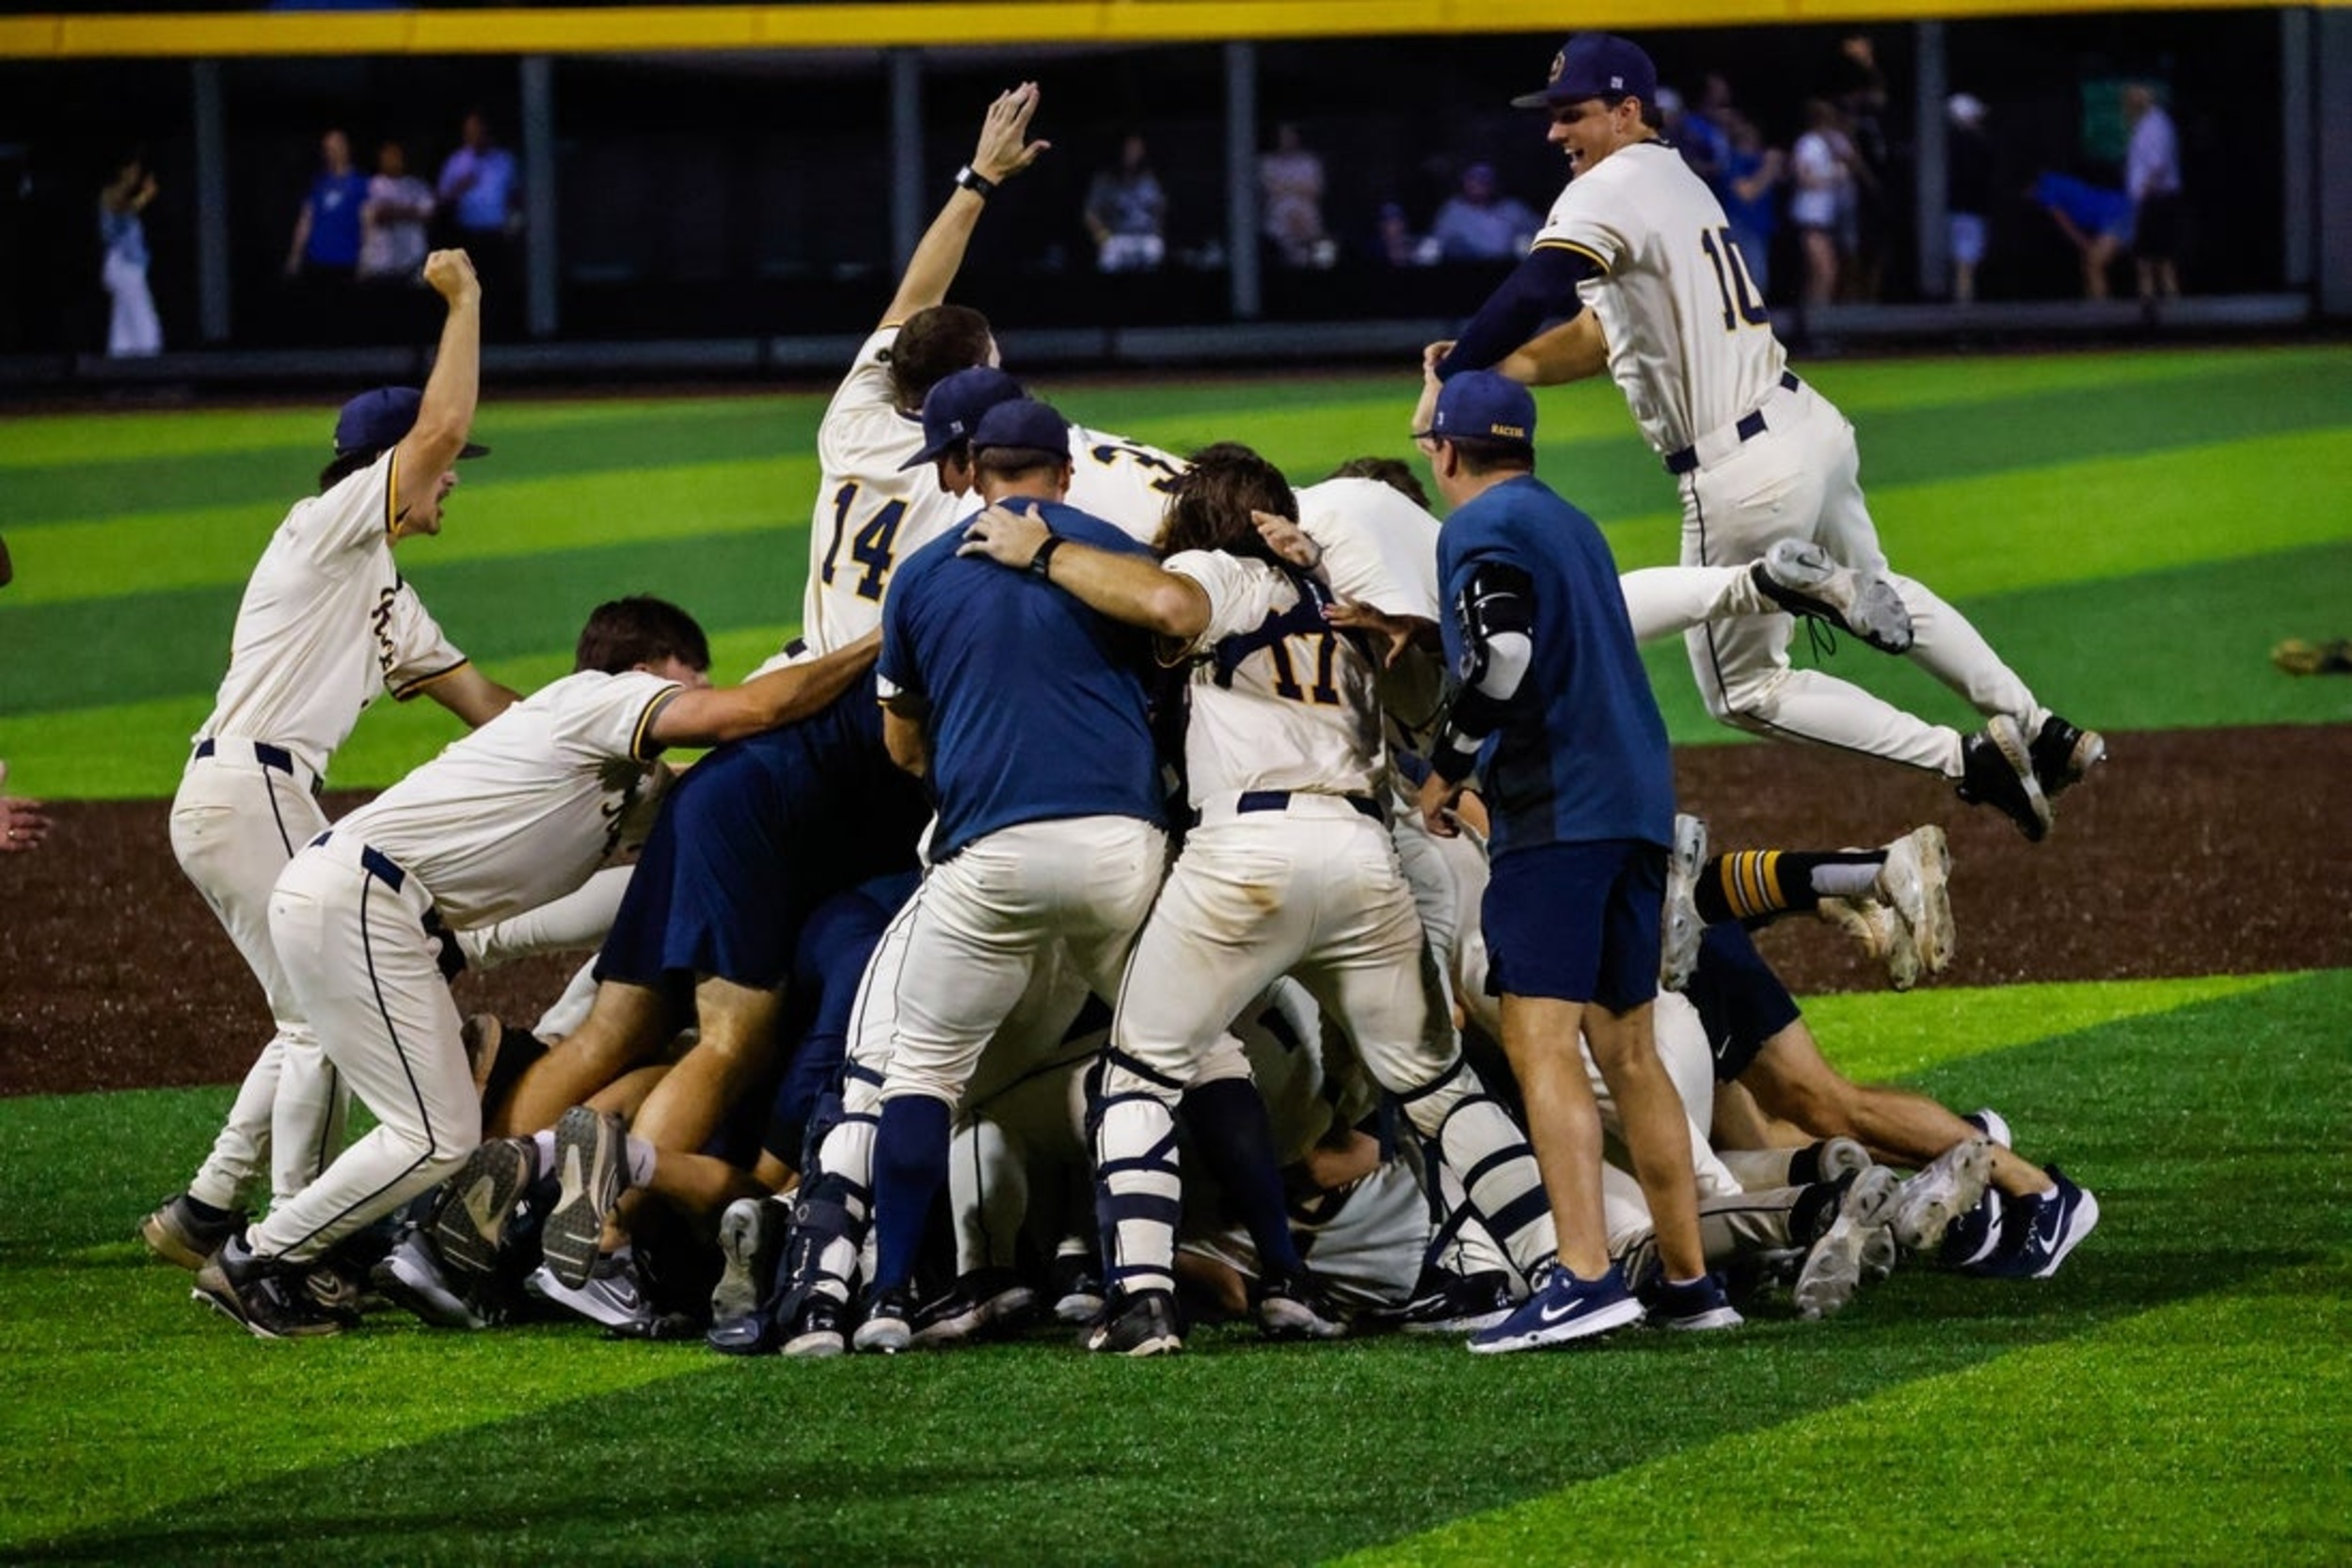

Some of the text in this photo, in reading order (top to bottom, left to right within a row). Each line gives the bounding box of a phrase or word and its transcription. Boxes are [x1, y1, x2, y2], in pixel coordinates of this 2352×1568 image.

[1700, 226, 1770, 332] 10
[821, 480, 910, 605] 14
[1268, 607, 1343, 705] 17
